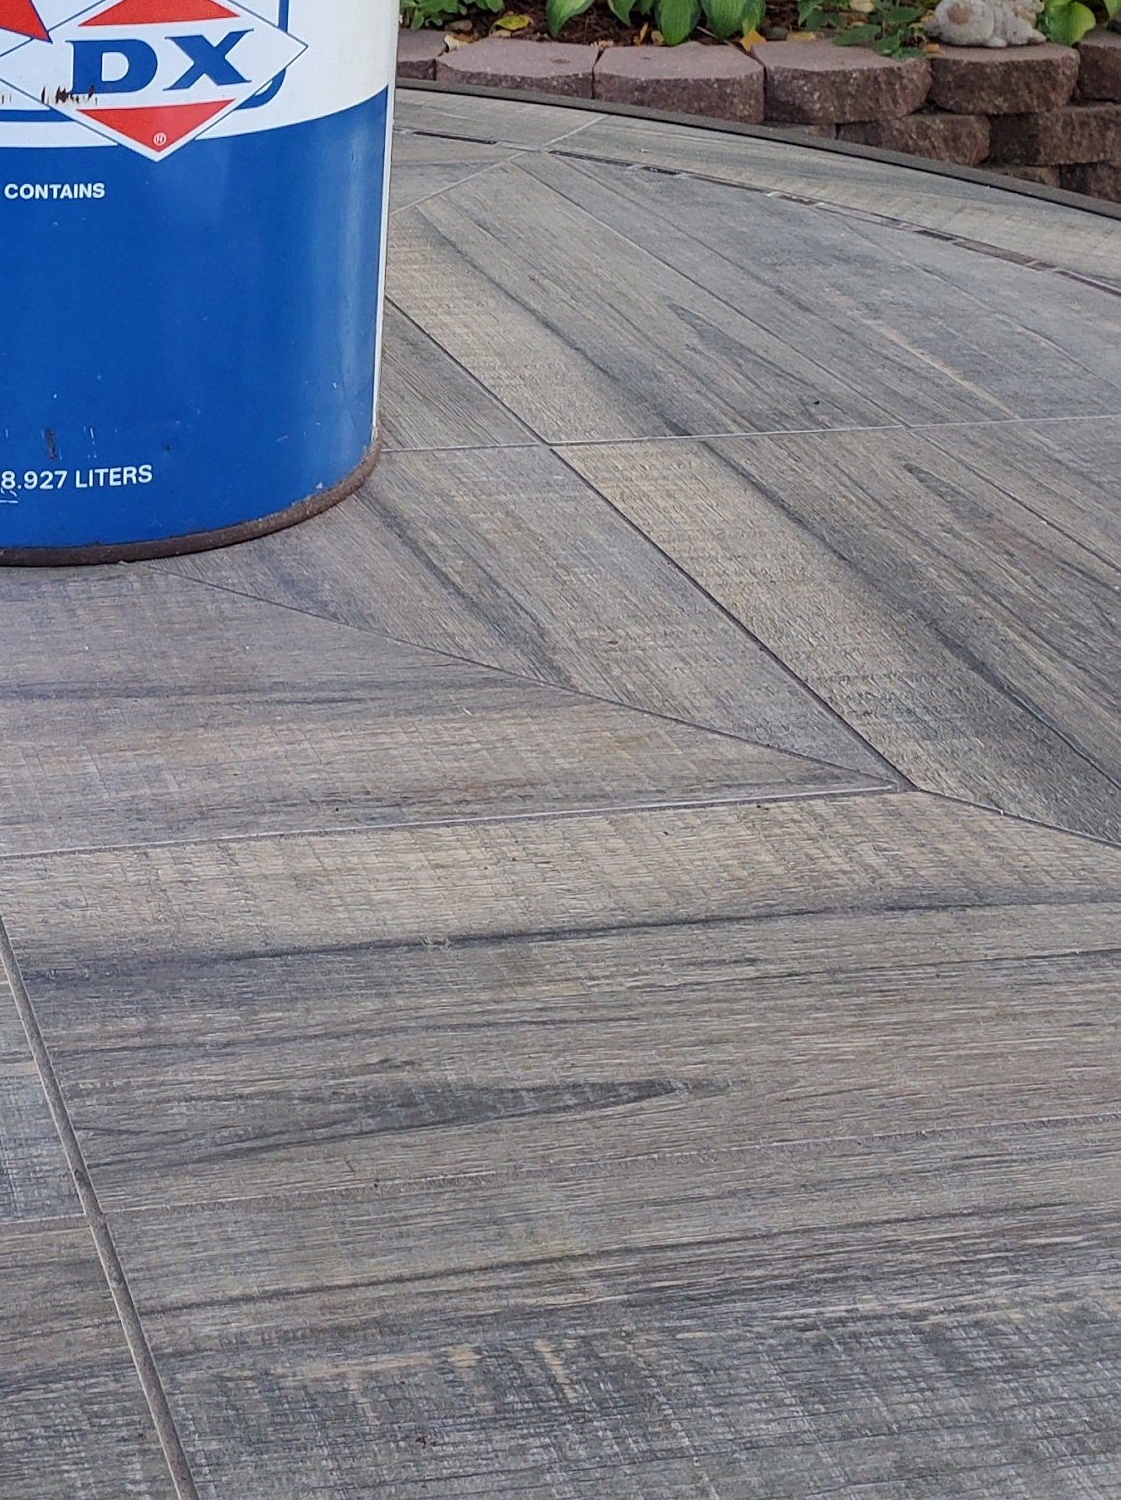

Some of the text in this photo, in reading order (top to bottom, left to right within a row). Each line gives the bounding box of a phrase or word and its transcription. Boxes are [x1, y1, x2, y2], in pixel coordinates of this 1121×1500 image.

[65, 28, 254, 95] DX
[4, 182, 106, 200] CONTAINS
[75, 464, 153, 489] LITERS
